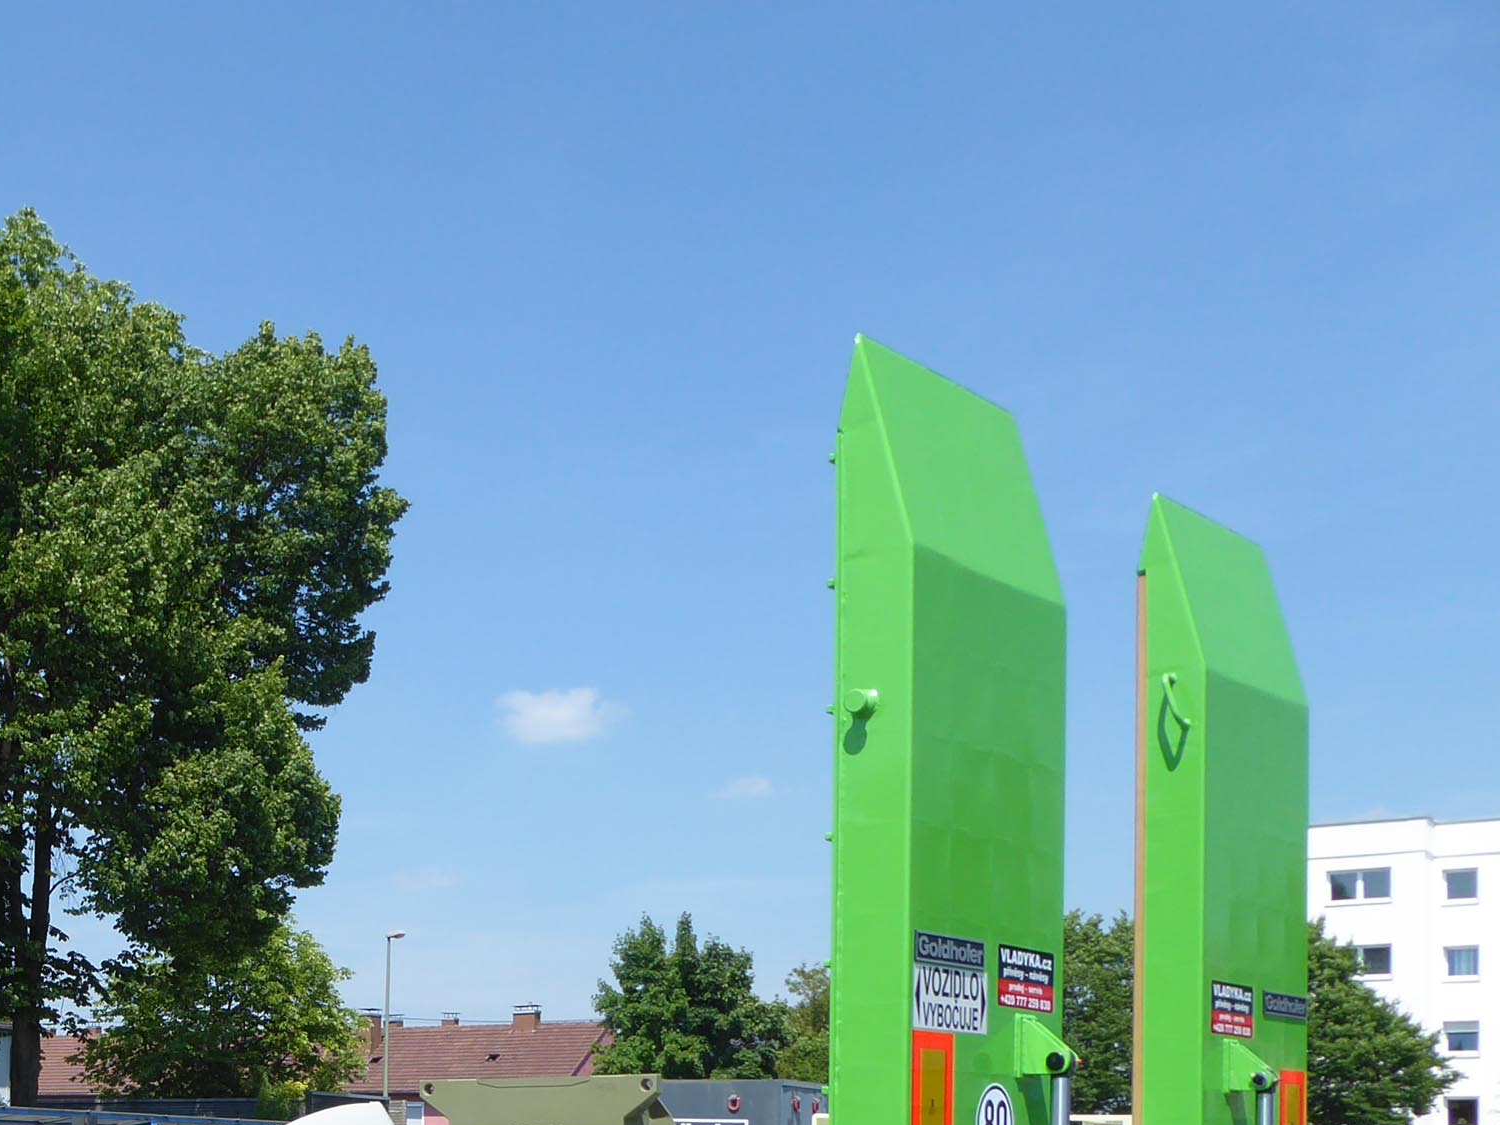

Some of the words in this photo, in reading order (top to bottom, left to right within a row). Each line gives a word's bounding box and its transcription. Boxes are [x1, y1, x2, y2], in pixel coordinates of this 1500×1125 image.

[920, 934, 982, 964] Goldhofer
[1001, 948, 1052, 971] VLADYKA.cz
[923, 966, 979, 1001] VOZIDLO
